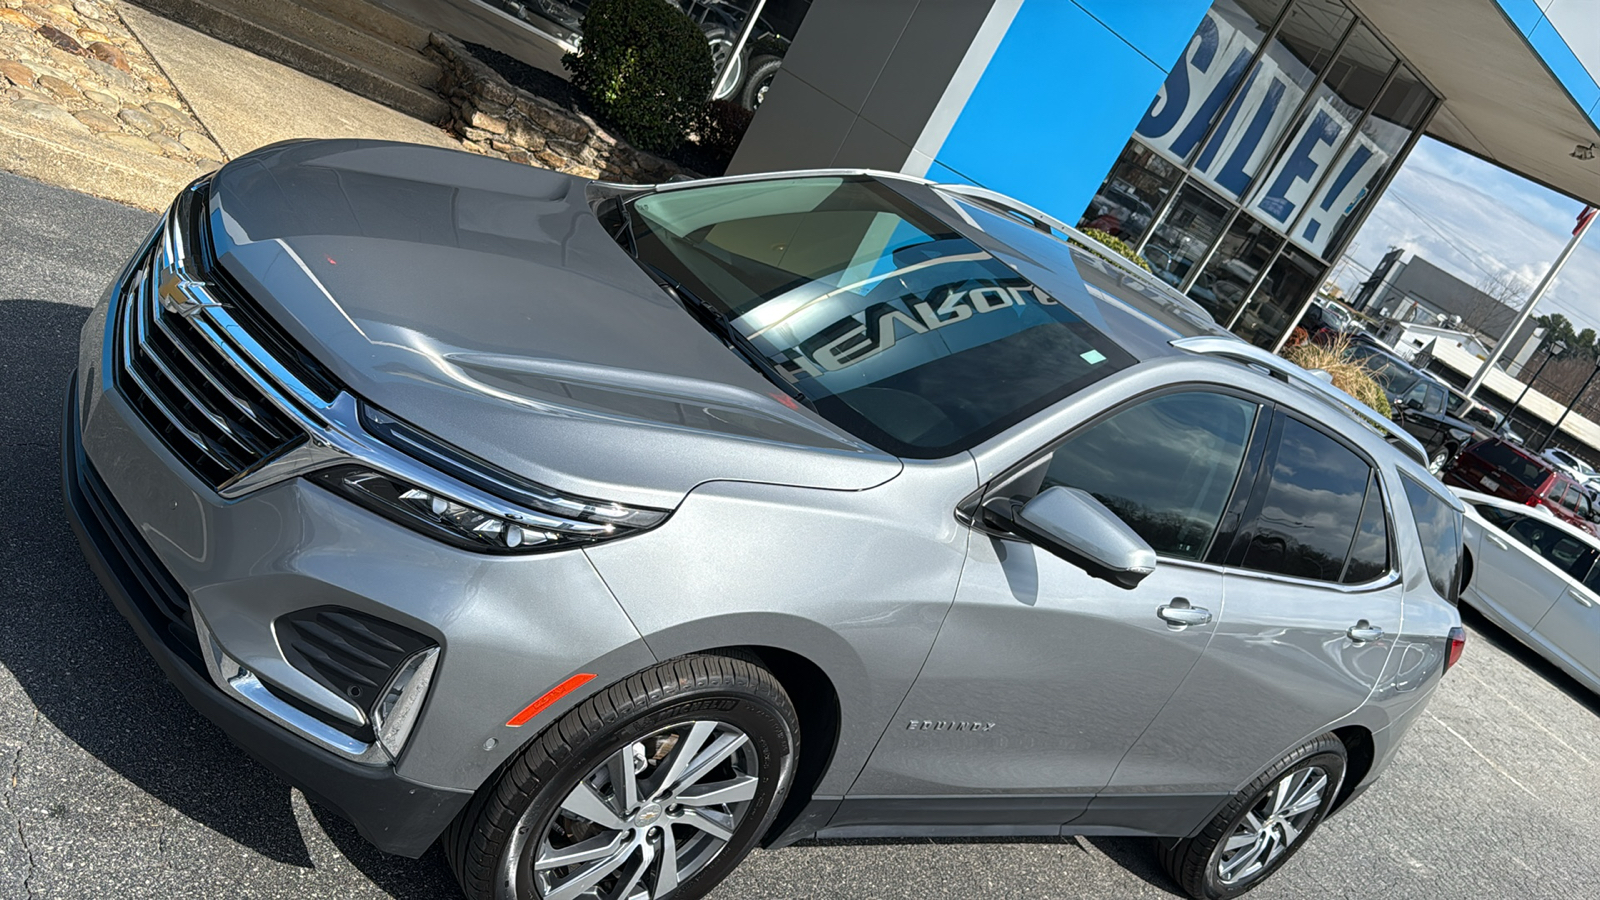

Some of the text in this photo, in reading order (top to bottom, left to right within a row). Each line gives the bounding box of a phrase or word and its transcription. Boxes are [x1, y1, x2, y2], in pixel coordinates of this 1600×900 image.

[1135, 13, 1373, 243] SALE!
[658, 700, 737, 717] MICHELIN
[906, 719, 996, 732] EQUINOX
